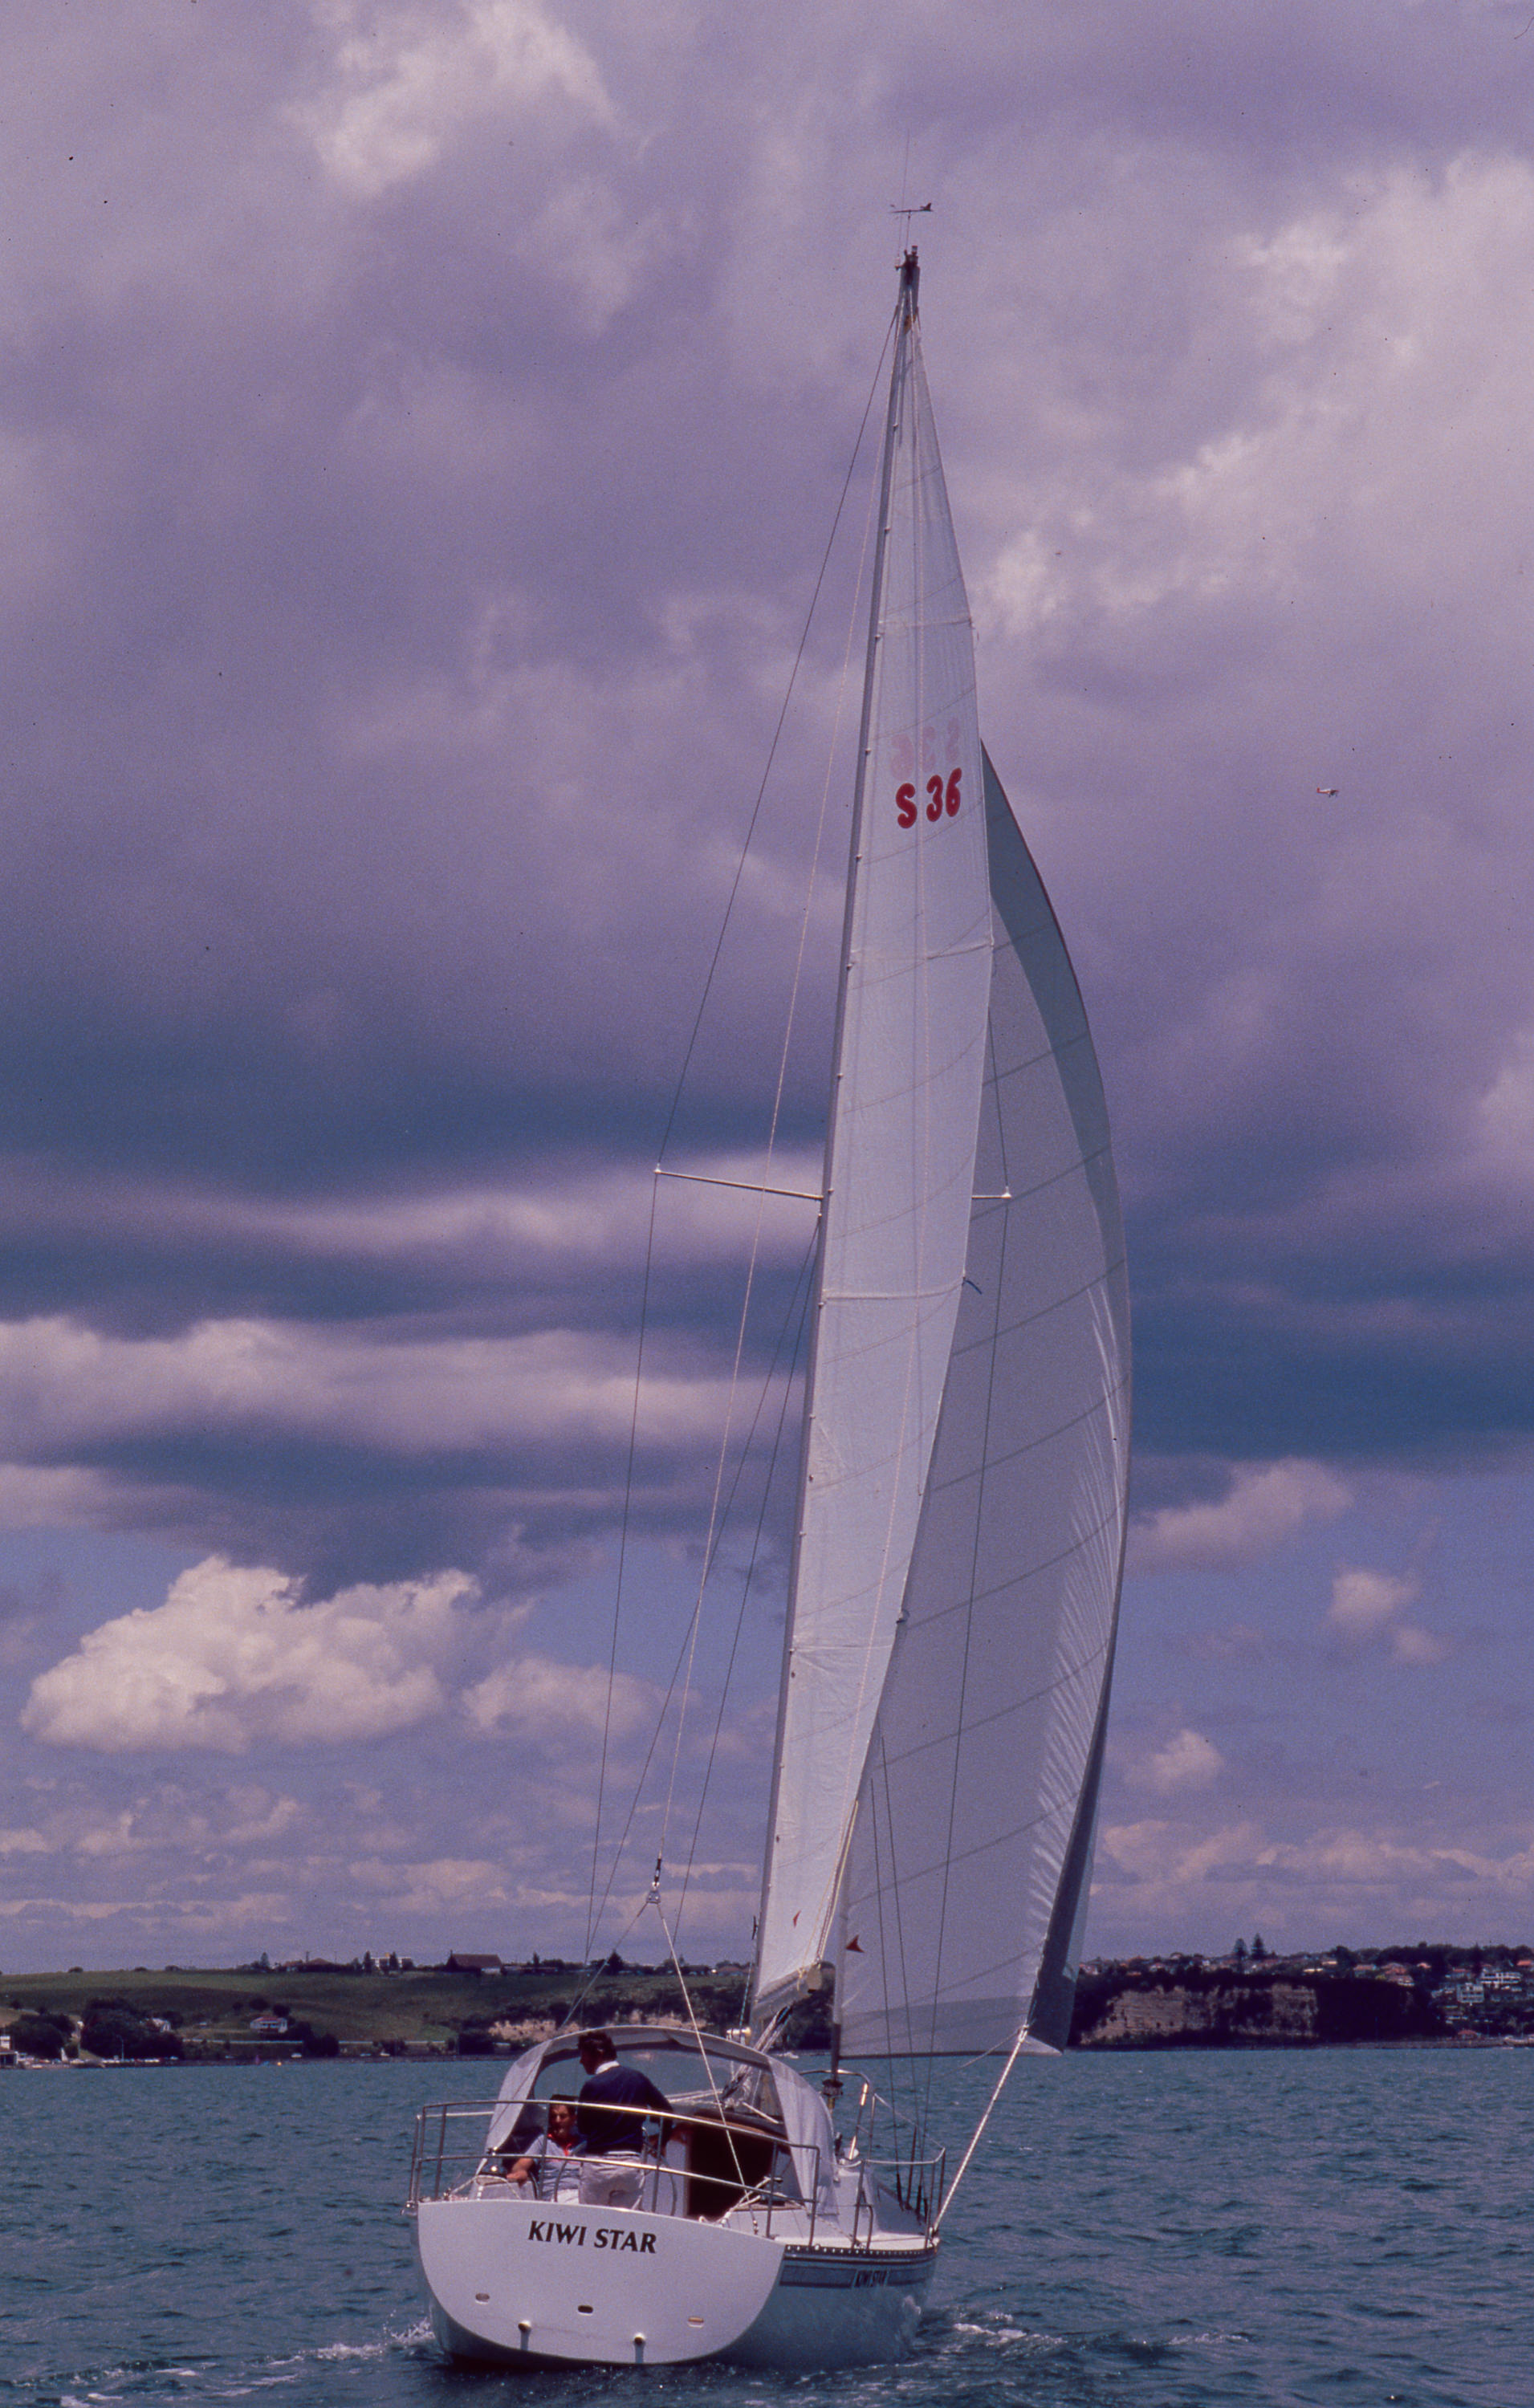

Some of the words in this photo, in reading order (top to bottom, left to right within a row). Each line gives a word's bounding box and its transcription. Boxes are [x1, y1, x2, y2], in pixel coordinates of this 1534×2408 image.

[895, 782, 918, 829] S
[926, 767, 962, 823] 36
[528, 2220, 587, 2246] KIWI
[594, 2228, 657, 2254] STAR
